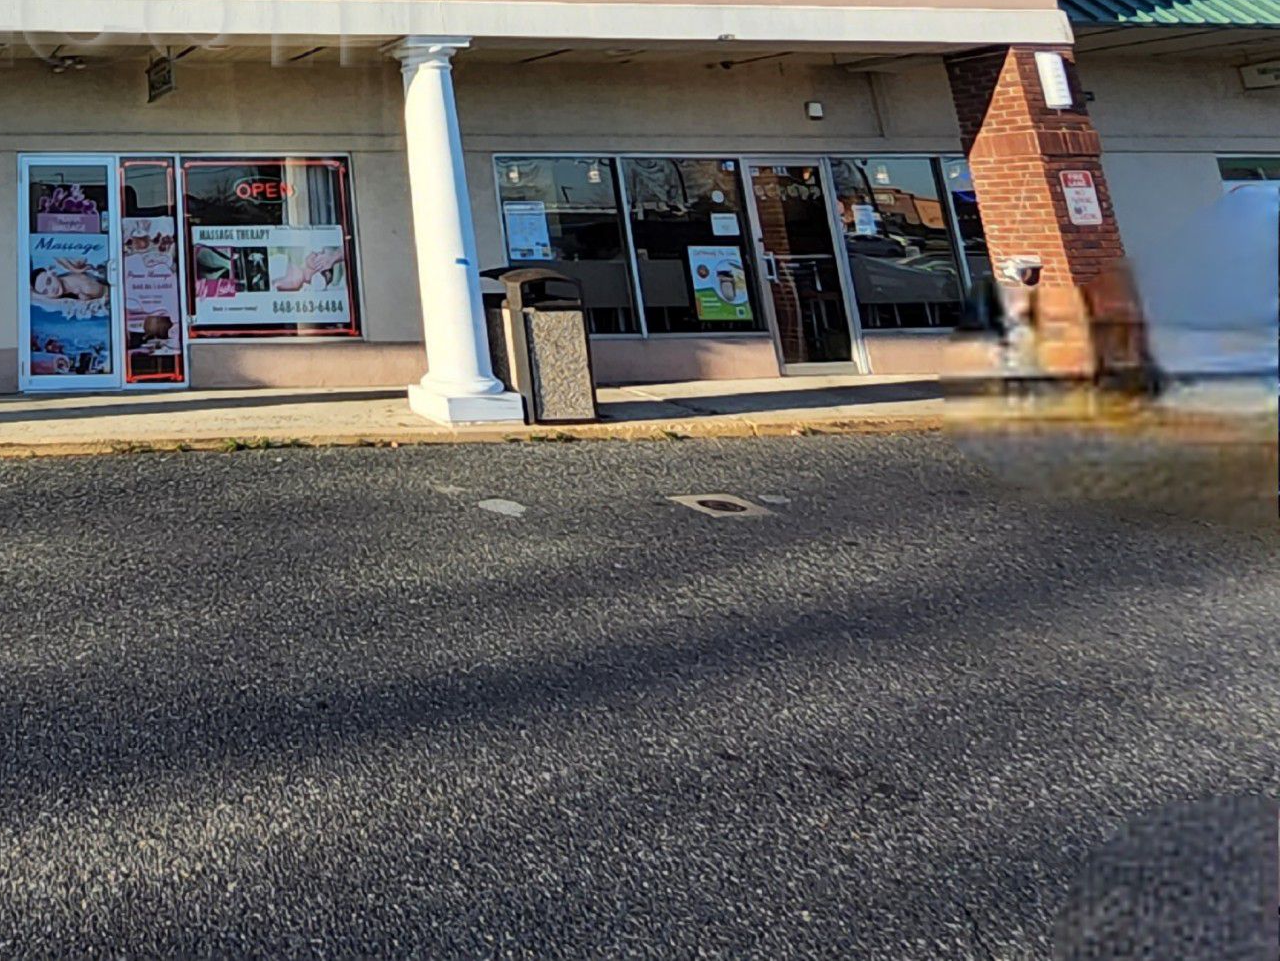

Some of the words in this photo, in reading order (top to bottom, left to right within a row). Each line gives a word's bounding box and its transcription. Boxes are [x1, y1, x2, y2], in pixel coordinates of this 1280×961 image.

[236, 181, 295, 199] OPEN
[199, 229, 234, 241] MASSAGE
[236, 228, 270, 241] THERAPY
[34, 237, 104, 255] Massage
